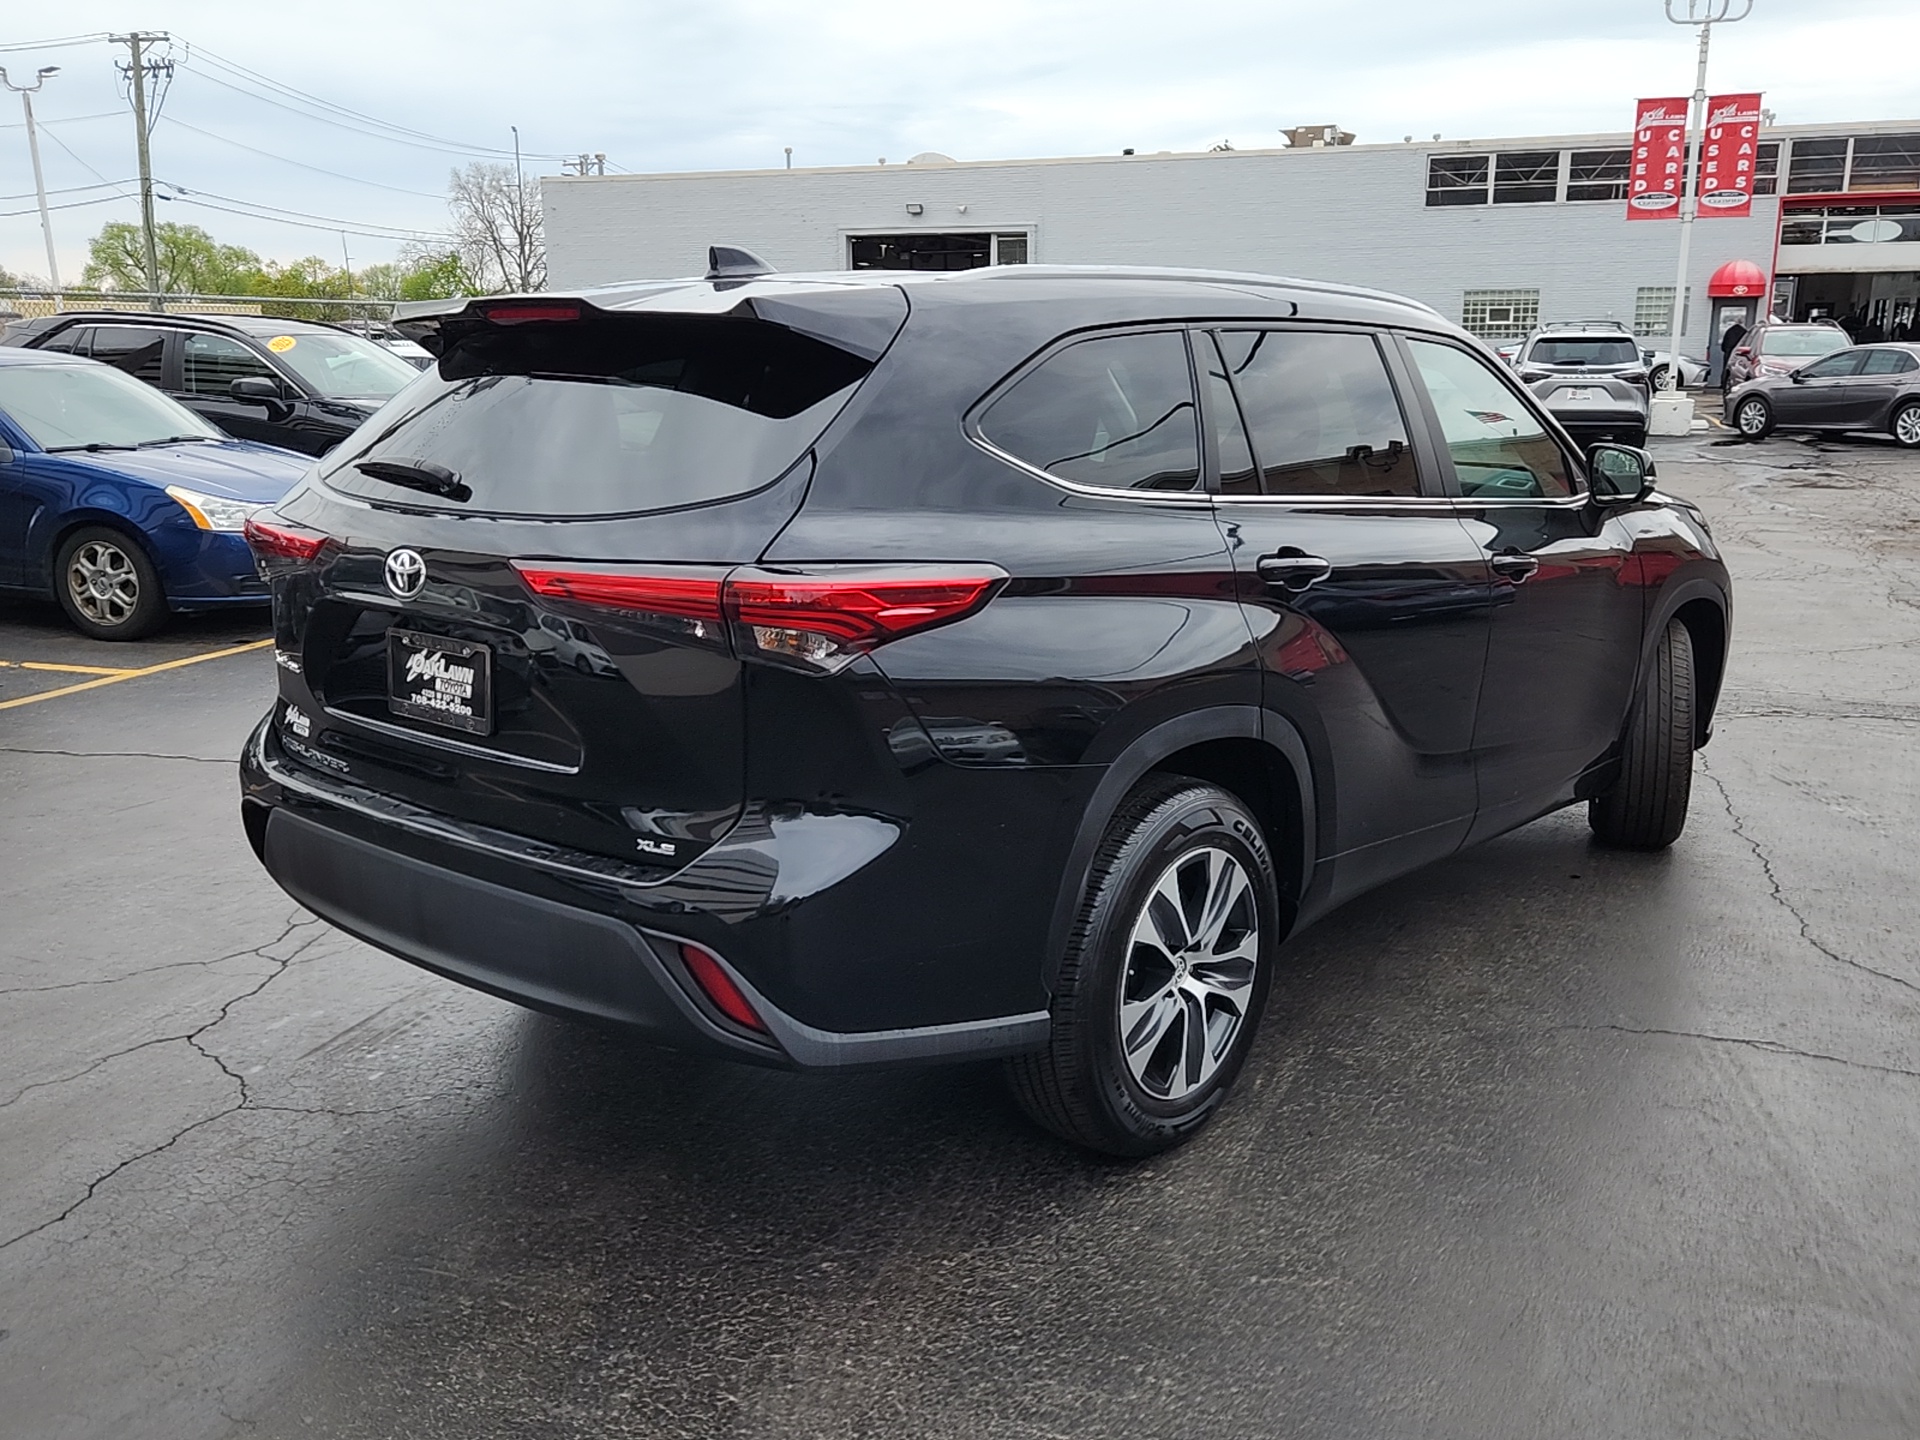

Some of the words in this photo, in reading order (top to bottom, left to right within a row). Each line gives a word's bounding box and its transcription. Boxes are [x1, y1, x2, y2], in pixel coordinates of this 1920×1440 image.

[1634, 131, 1651, 191] USED
[1664, 129, 1681, 190] CARS
[1704, 128, 1722, 189] USED
[1735, 126, 1753, 188] CARS
[440, 680, 468, 697] TOYOTA
[636, 838, 676, 856] XLE
